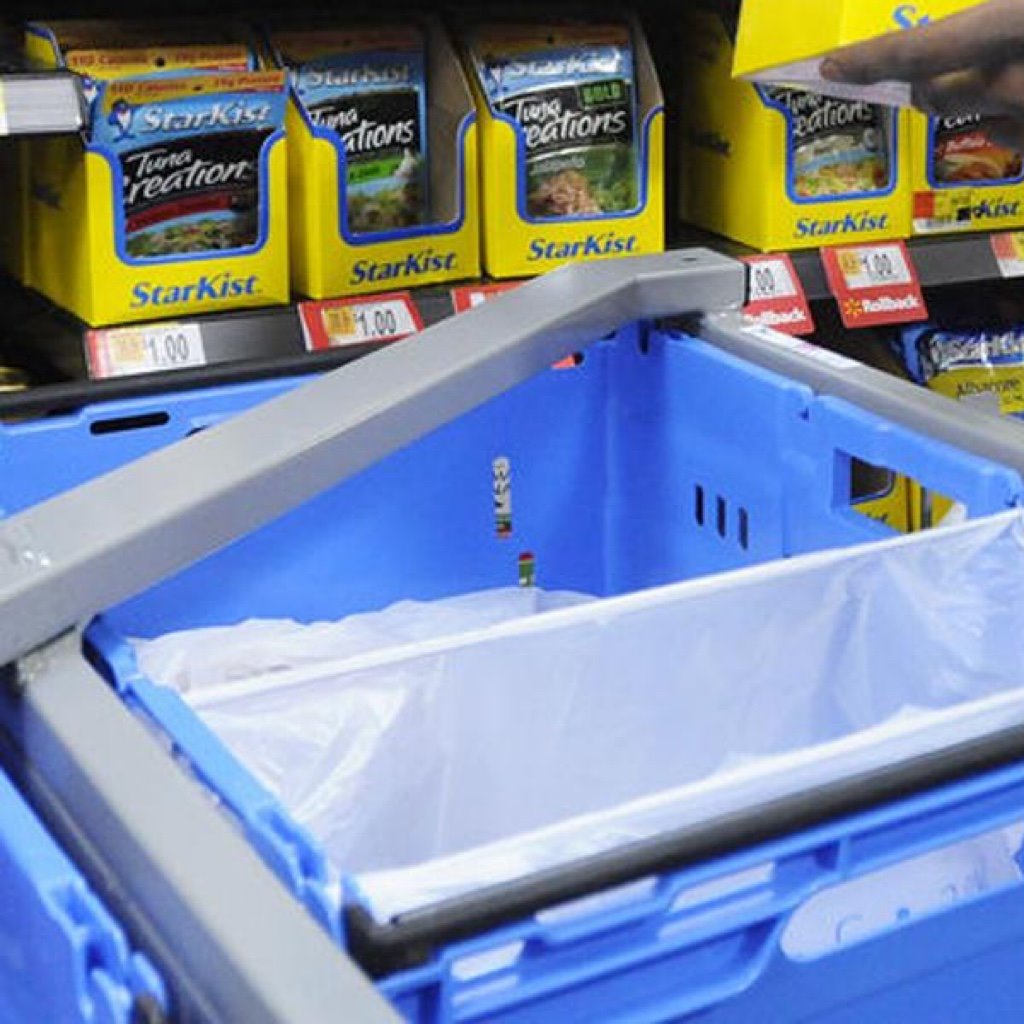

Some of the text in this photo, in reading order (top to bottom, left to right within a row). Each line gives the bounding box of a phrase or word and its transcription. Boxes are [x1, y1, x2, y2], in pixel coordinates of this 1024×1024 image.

[141, 98, 272, 131] StarKist
[505, 95, 562, 122] Tuna
[793, 97, 872, 137] eations
[343, 119, 415, 151] ations
[524, 109, 627, 149] eations
[126, 147, 193, 179] Tuna
[125, 158, 251, 204] reation
[792, 209, 889, 239] StarKist
[526, 233, 638, 262] StarKist
[350, 247, 457, 286] StarKist
[130, 271, 258, 308] StarKist
[862, 294, 920, 314] Rollback
[355, 308, 399, 336] 1.00
[145, 332, 190, 365] 1.00
